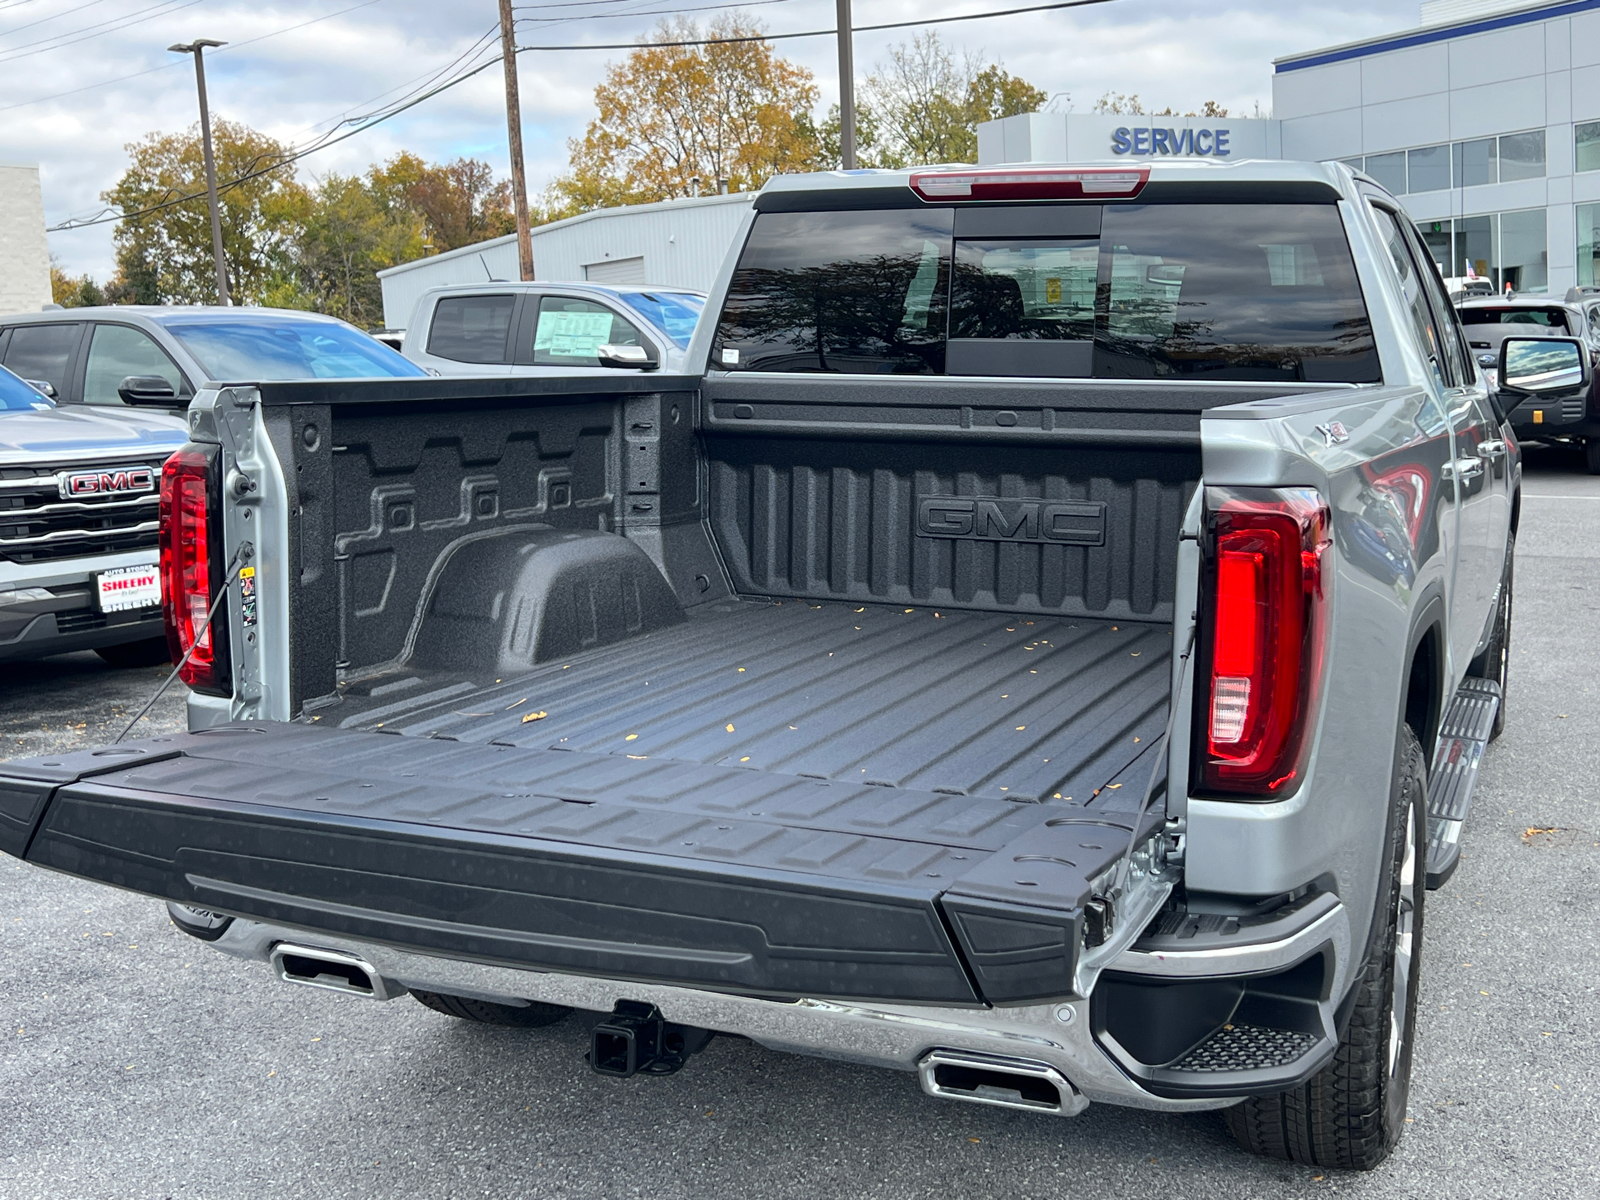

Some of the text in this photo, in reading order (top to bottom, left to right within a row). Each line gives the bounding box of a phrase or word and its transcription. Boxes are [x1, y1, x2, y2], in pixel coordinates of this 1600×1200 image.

[1111, 126, 1230, 155] SERVICE
[70, 470, 152, 494] GMC
[919, 499, 1101, 542] GMC
[104, 568, 125, 576] AUTO
[102, 575, 155, 592] SHEEHY
[102, 597, 160, 613] SHEEHY
